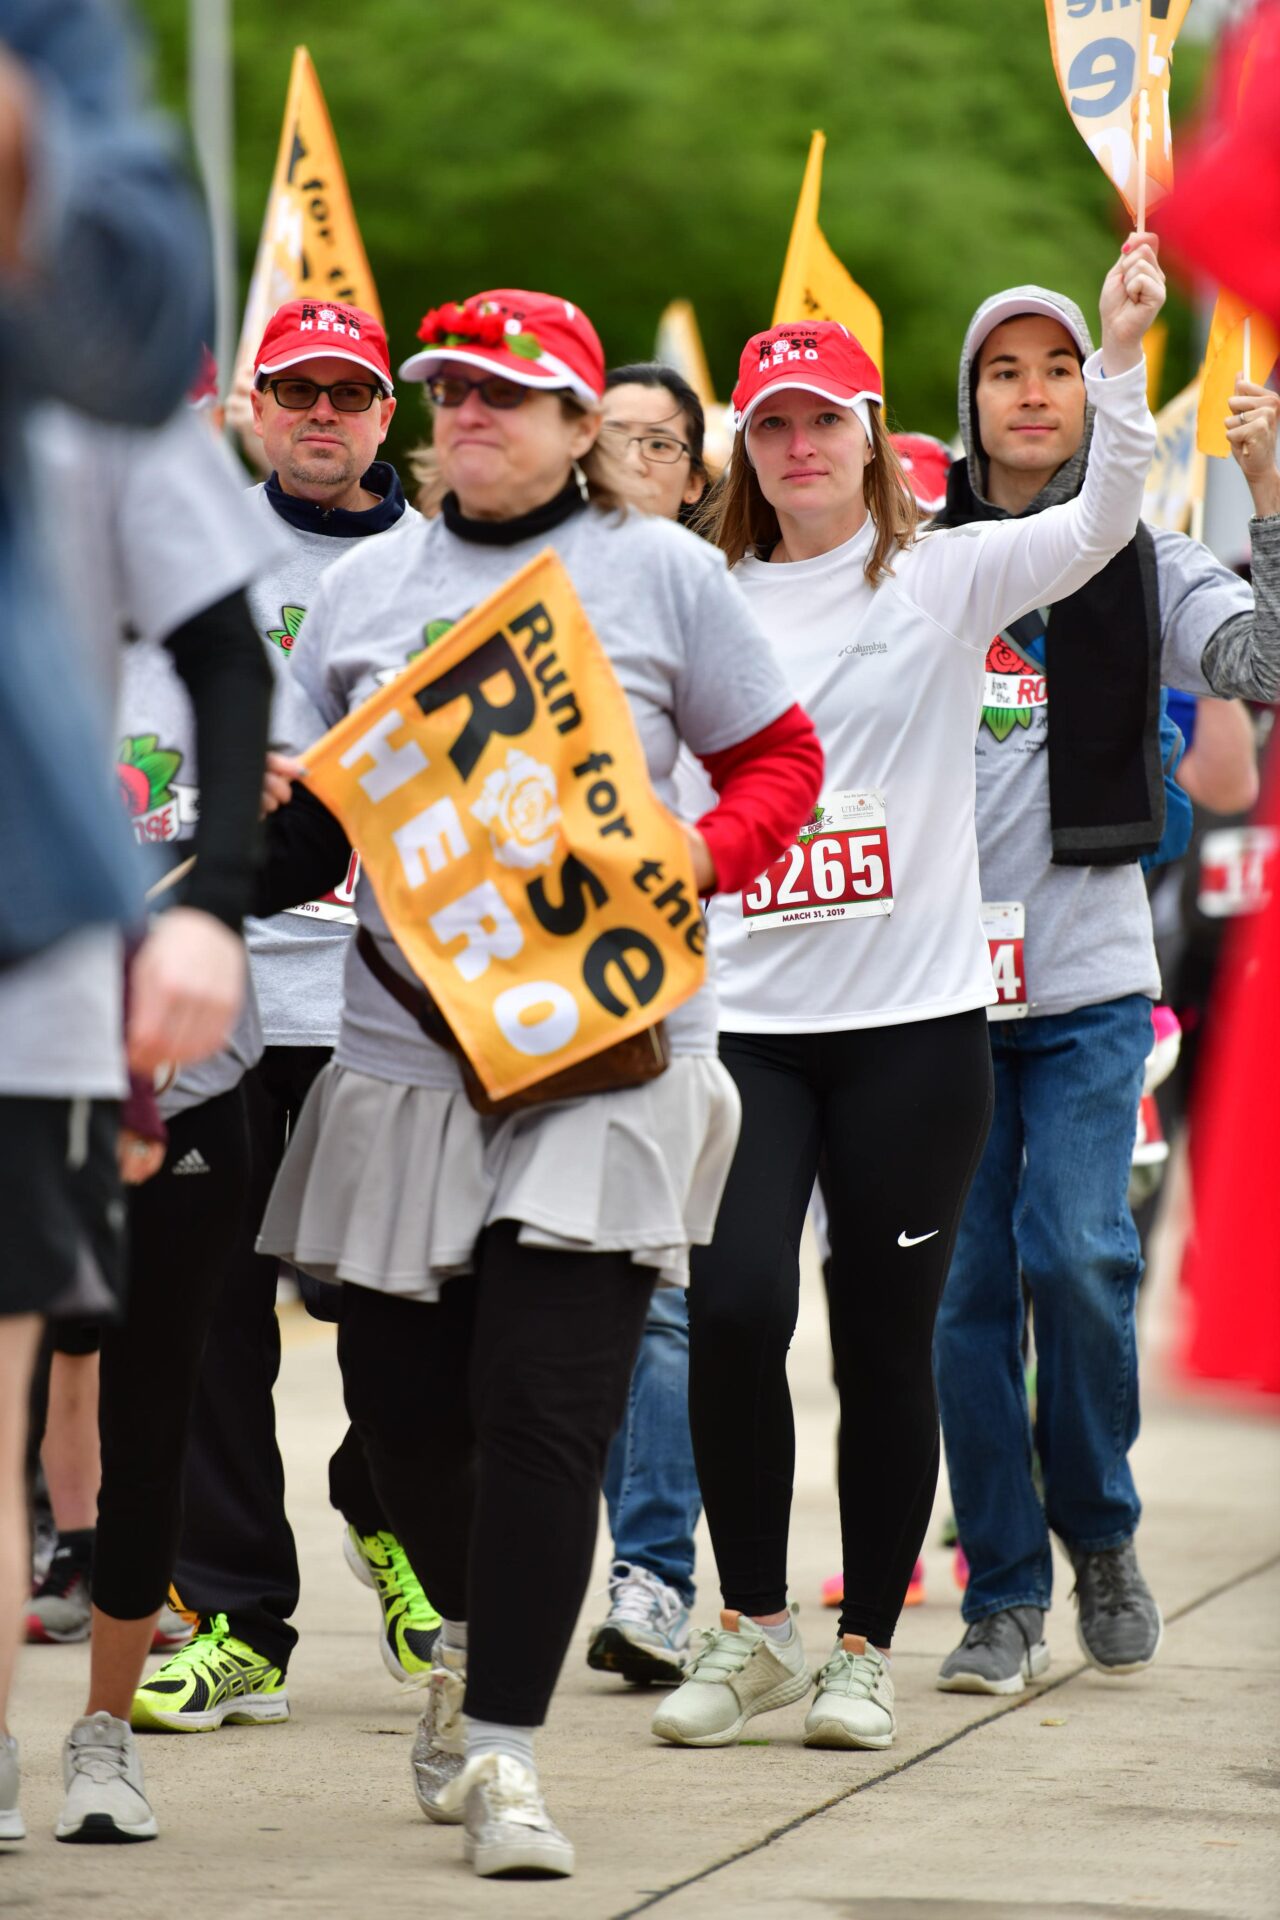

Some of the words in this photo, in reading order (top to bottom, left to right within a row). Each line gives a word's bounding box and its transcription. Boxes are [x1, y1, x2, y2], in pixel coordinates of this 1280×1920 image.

[300, 320, 360, 341] HERO
[301, 309, 361, 330] Rse
[758, 349, 819, 373] HERO
[759, 338, 818, 361] Rse
[507, 602, 585, 736] Run
[571, 750, 635, 843] for
[629, 859, 706, 957] the
[413, 631, 666, 1018] Rse
[339, 709, 580, 1056] HERO
[746, 834, 885, 910] 3265
[301, 904, 320, 913] 2019
[782, 912, 811, 922] MARCH
[813, 910, 824, 920] 31,
[826, 908, 846, 917] 2019
